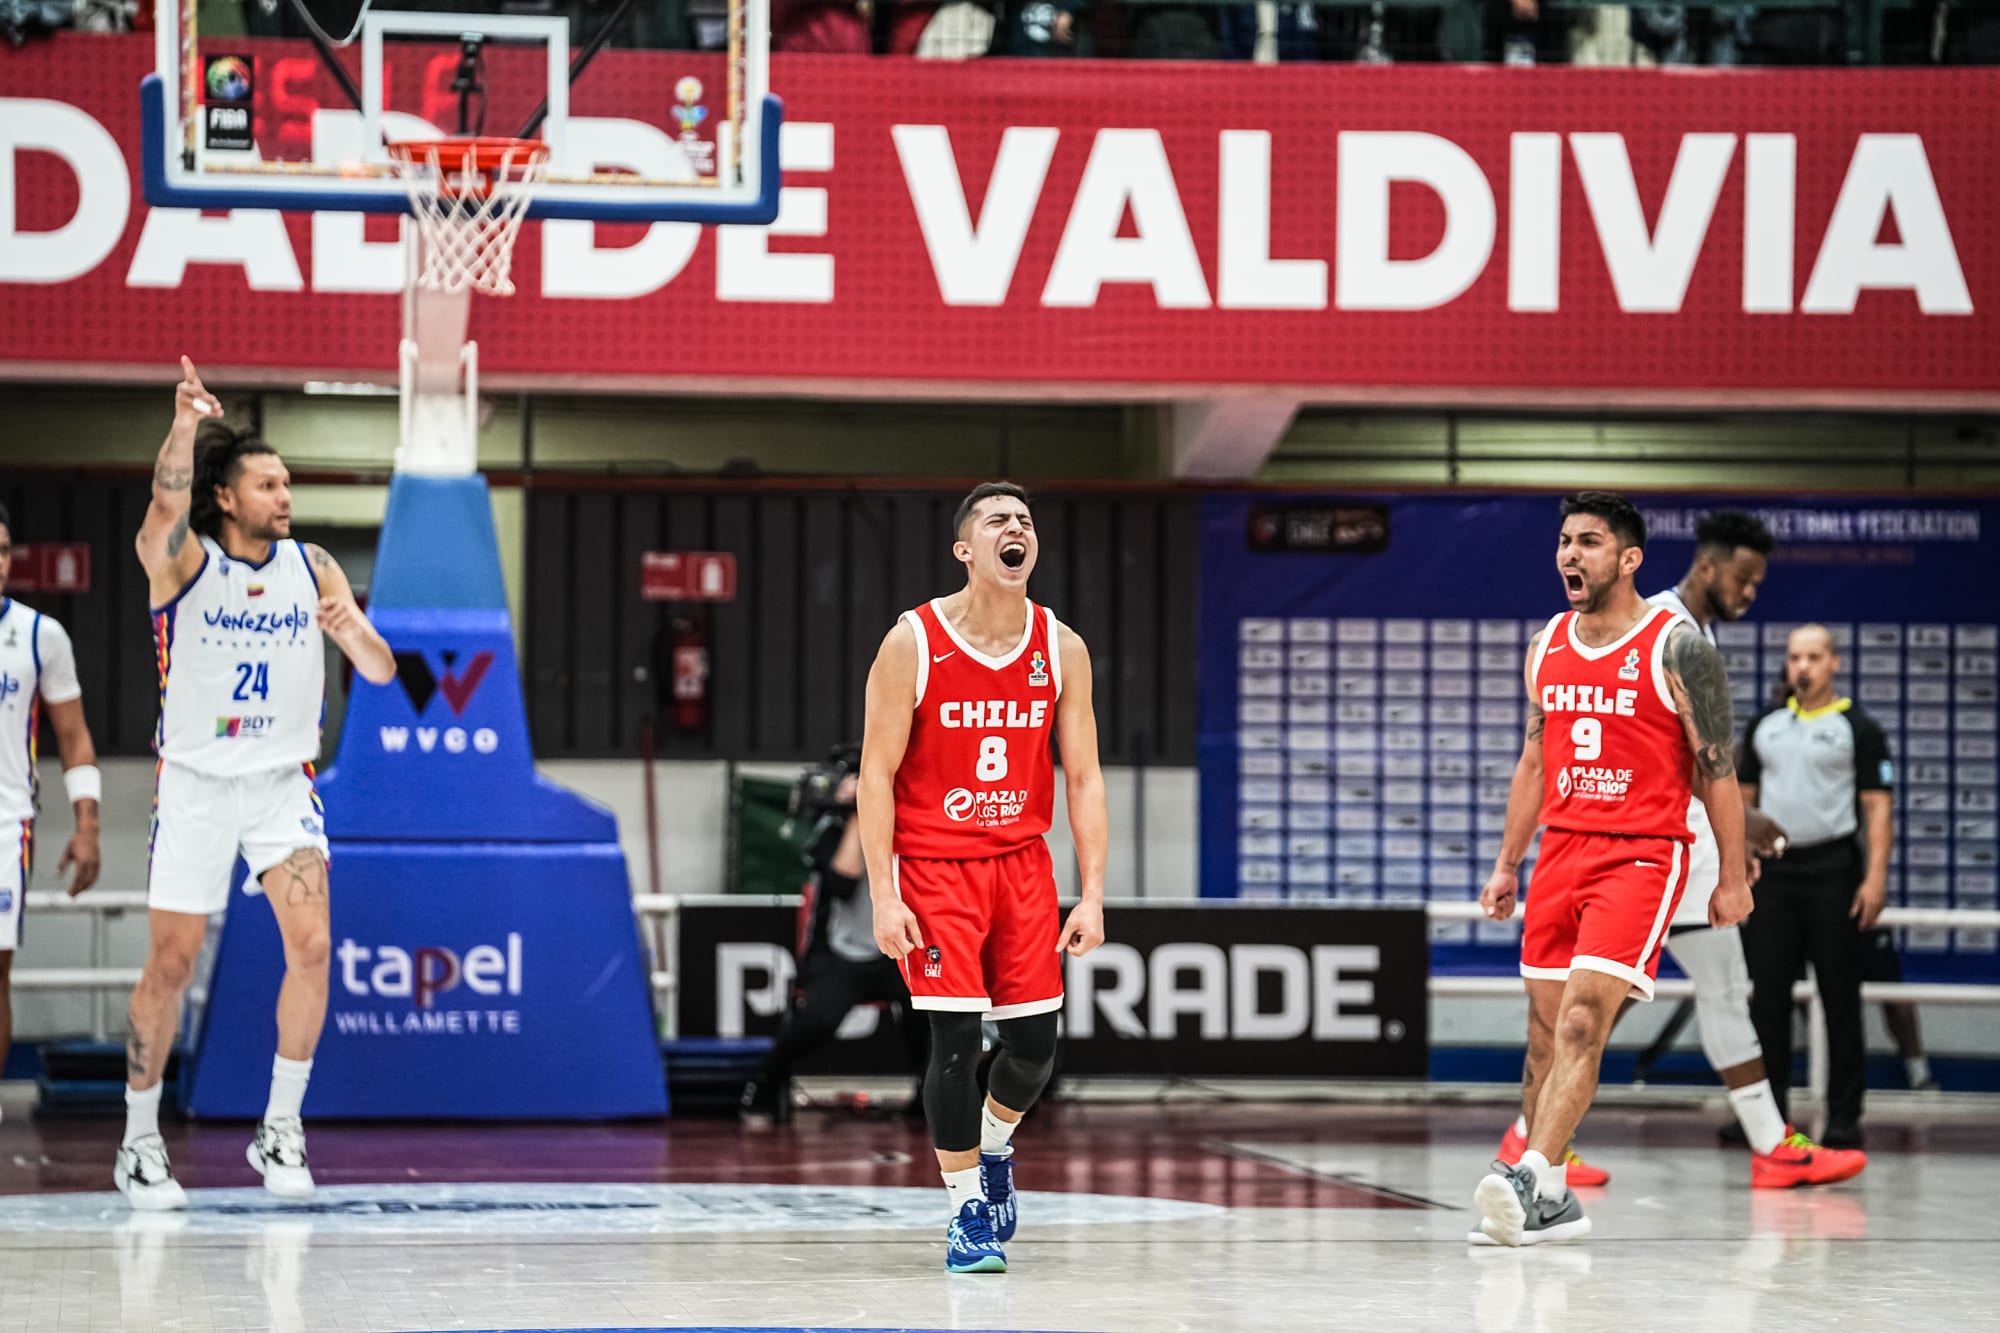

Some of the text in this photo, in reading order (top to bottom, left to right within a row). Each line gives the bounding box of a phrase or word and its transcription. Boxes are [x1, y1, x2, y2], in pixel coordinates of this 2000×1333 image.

[209, 107, 248, 130] FIBA
[541, 117, 834, 301] DE
[891, 124, 1973, 315] VALDIVIA
[232, 661, 269, 701] 24
[1542, 684, 1638, 717] CHILE
[242, 715, 276, 730] BDT
[940, 700, 1048, 729] CHILE
[1571, 717, 1602, 760] 9
[976, 736, 1009, 782] 8
[1571, 766, 1633, 782] PLAZA DE
[1574, 779, 1596, 793] LOS
[975, 790, 1017, 804] PLAZA
[977, 804, 998, 818] LOS
[337, 932, 523, 1008] tapel
[335, 1010, 521, 1035] WILLAMETTE
